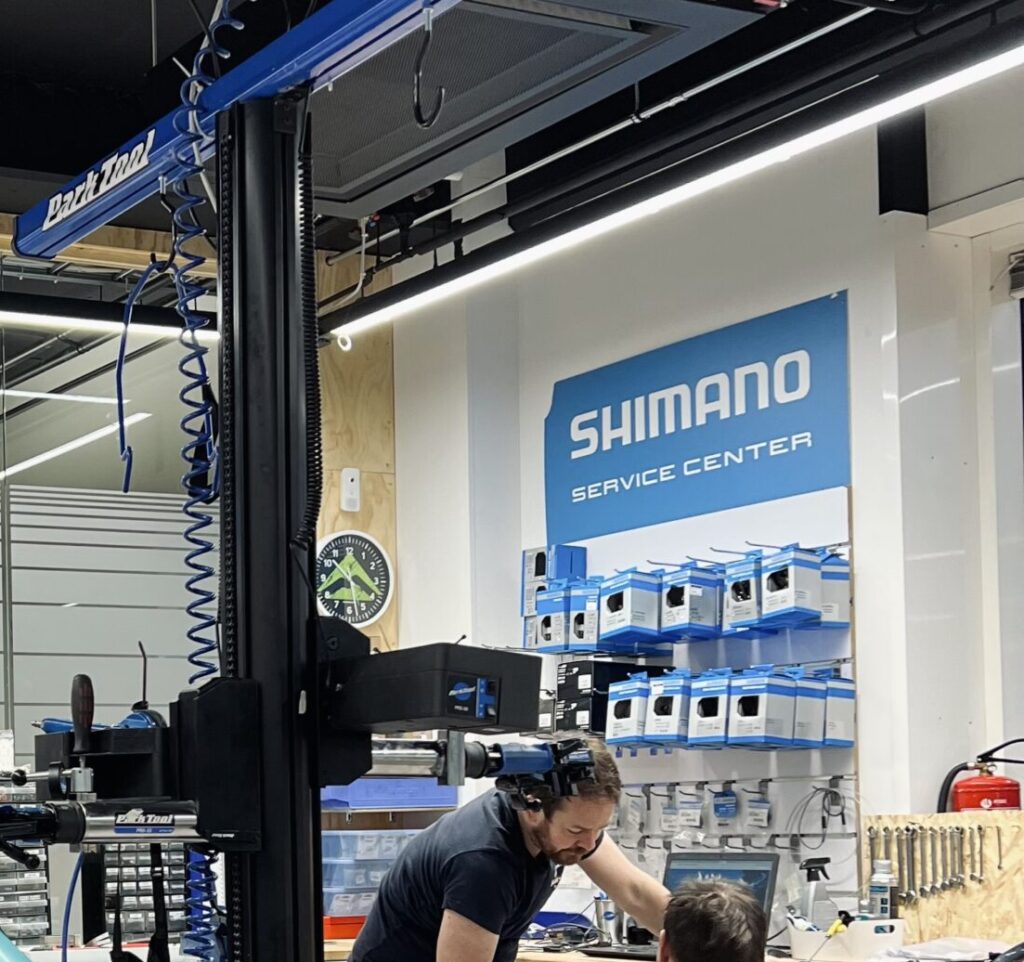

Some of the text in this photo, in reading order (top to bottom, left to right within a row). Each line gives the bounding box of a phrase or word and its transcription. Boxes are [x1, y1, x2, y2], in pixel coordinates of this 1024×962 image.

[42, 128, 157, 231] Park Tool
[569, 349, 811, 460] SHIMANO
[571, 431, 813, 503] SERVICE CENTER
[116, 813, 173, 824] Pk Tool
